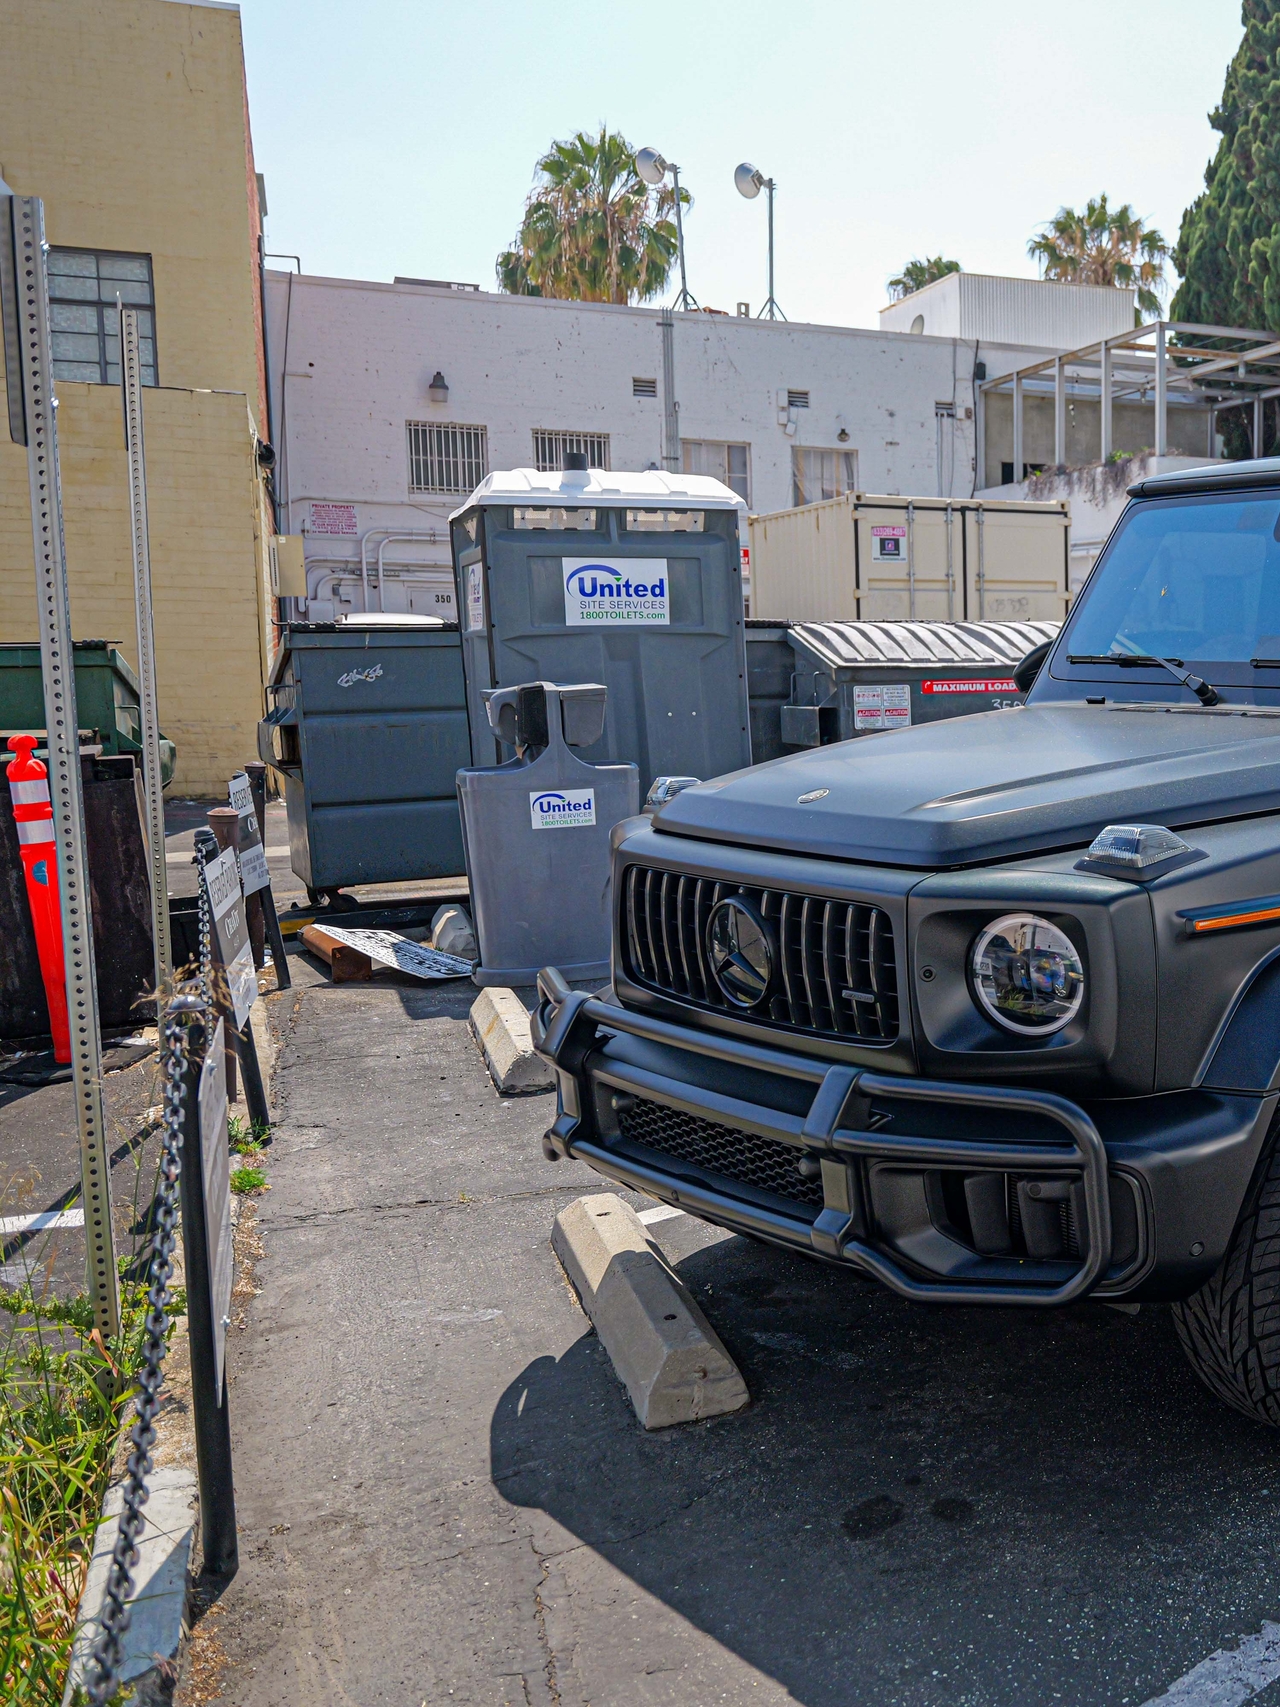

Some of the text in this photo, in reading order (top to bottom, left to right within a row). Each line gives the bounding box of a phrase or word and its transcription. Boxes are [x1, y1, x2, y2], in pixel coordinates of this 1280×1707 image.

[577, 577, 665, 598] United
[435, 594, 451, 603] 350
[580, 601, 665, 609] SITE SERVICES
[580, 611, 666, 620] 1800TOILETS.com
[932, 683, 986, 692] MAXIMUM
[539, 798, 592, 813] United
[558, 812, 593, 820] SERVICES
[541, 819, 593, 827] 1800TOILETS.com
